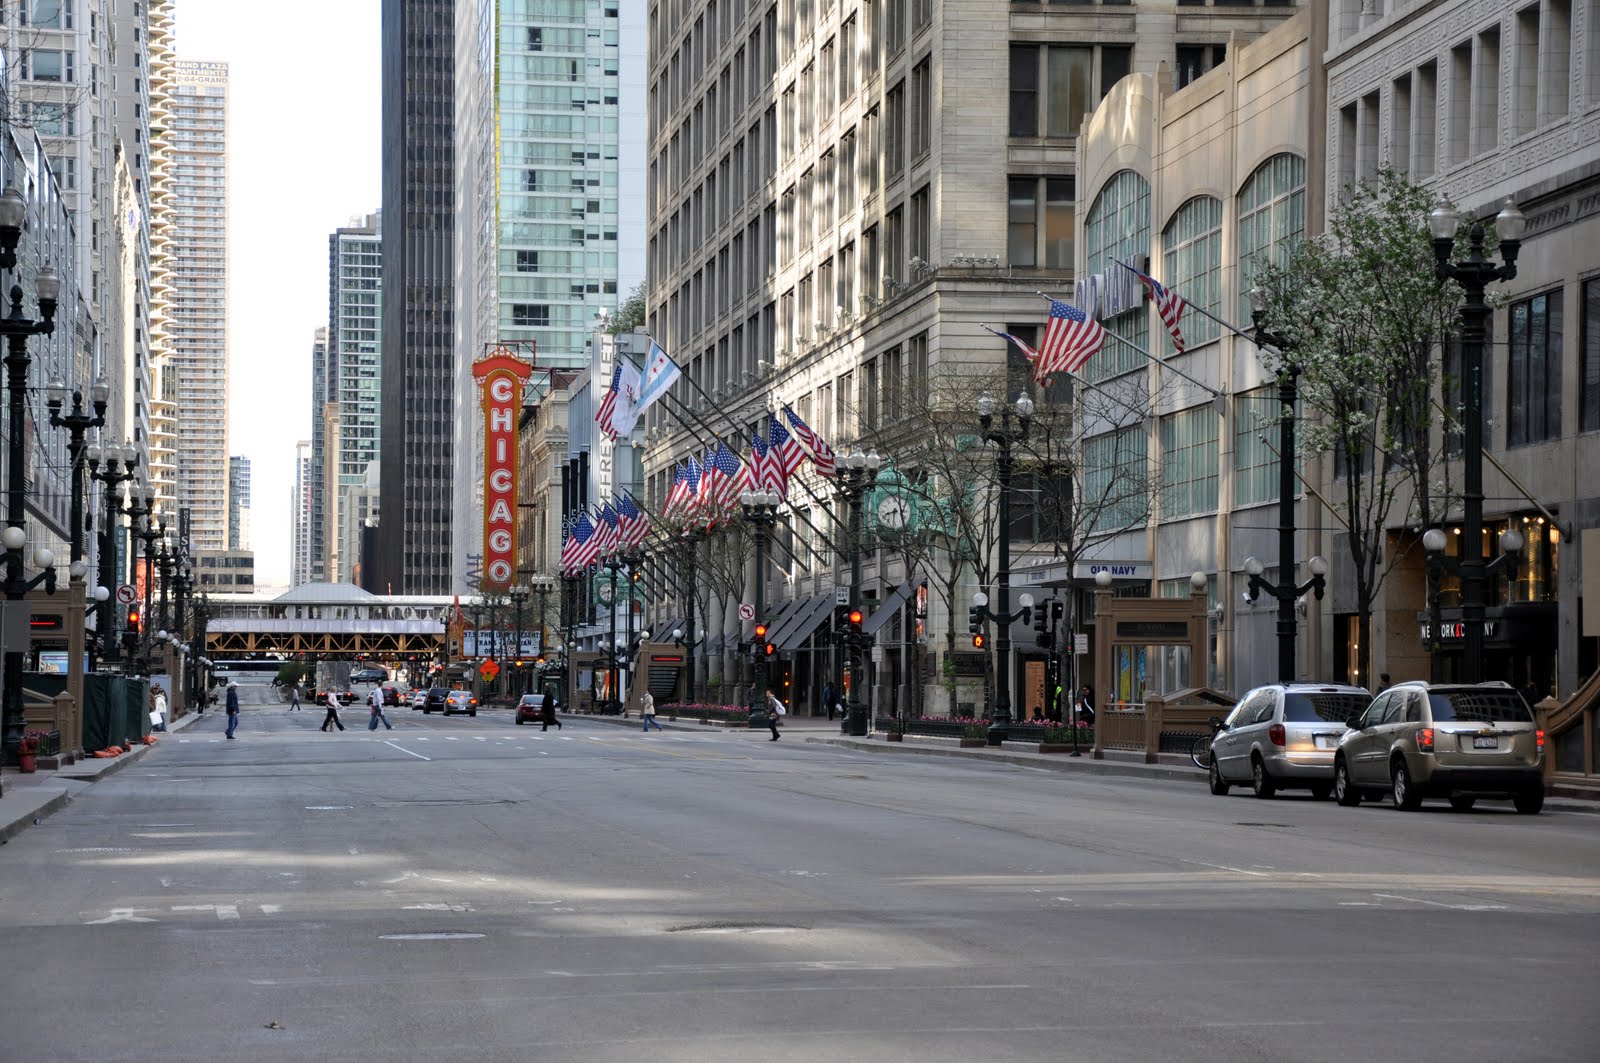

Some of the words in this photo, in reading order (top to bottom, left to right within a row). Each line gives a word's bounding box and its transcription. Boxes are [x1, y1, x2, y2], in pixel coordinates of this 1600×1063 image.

[600, 337, 612, 400] ALLET
[489, 377, 513, 583] CHICAGO
[180, 536, 189, 565] SAX
[1111, 566, 1136, 575] NAVY
